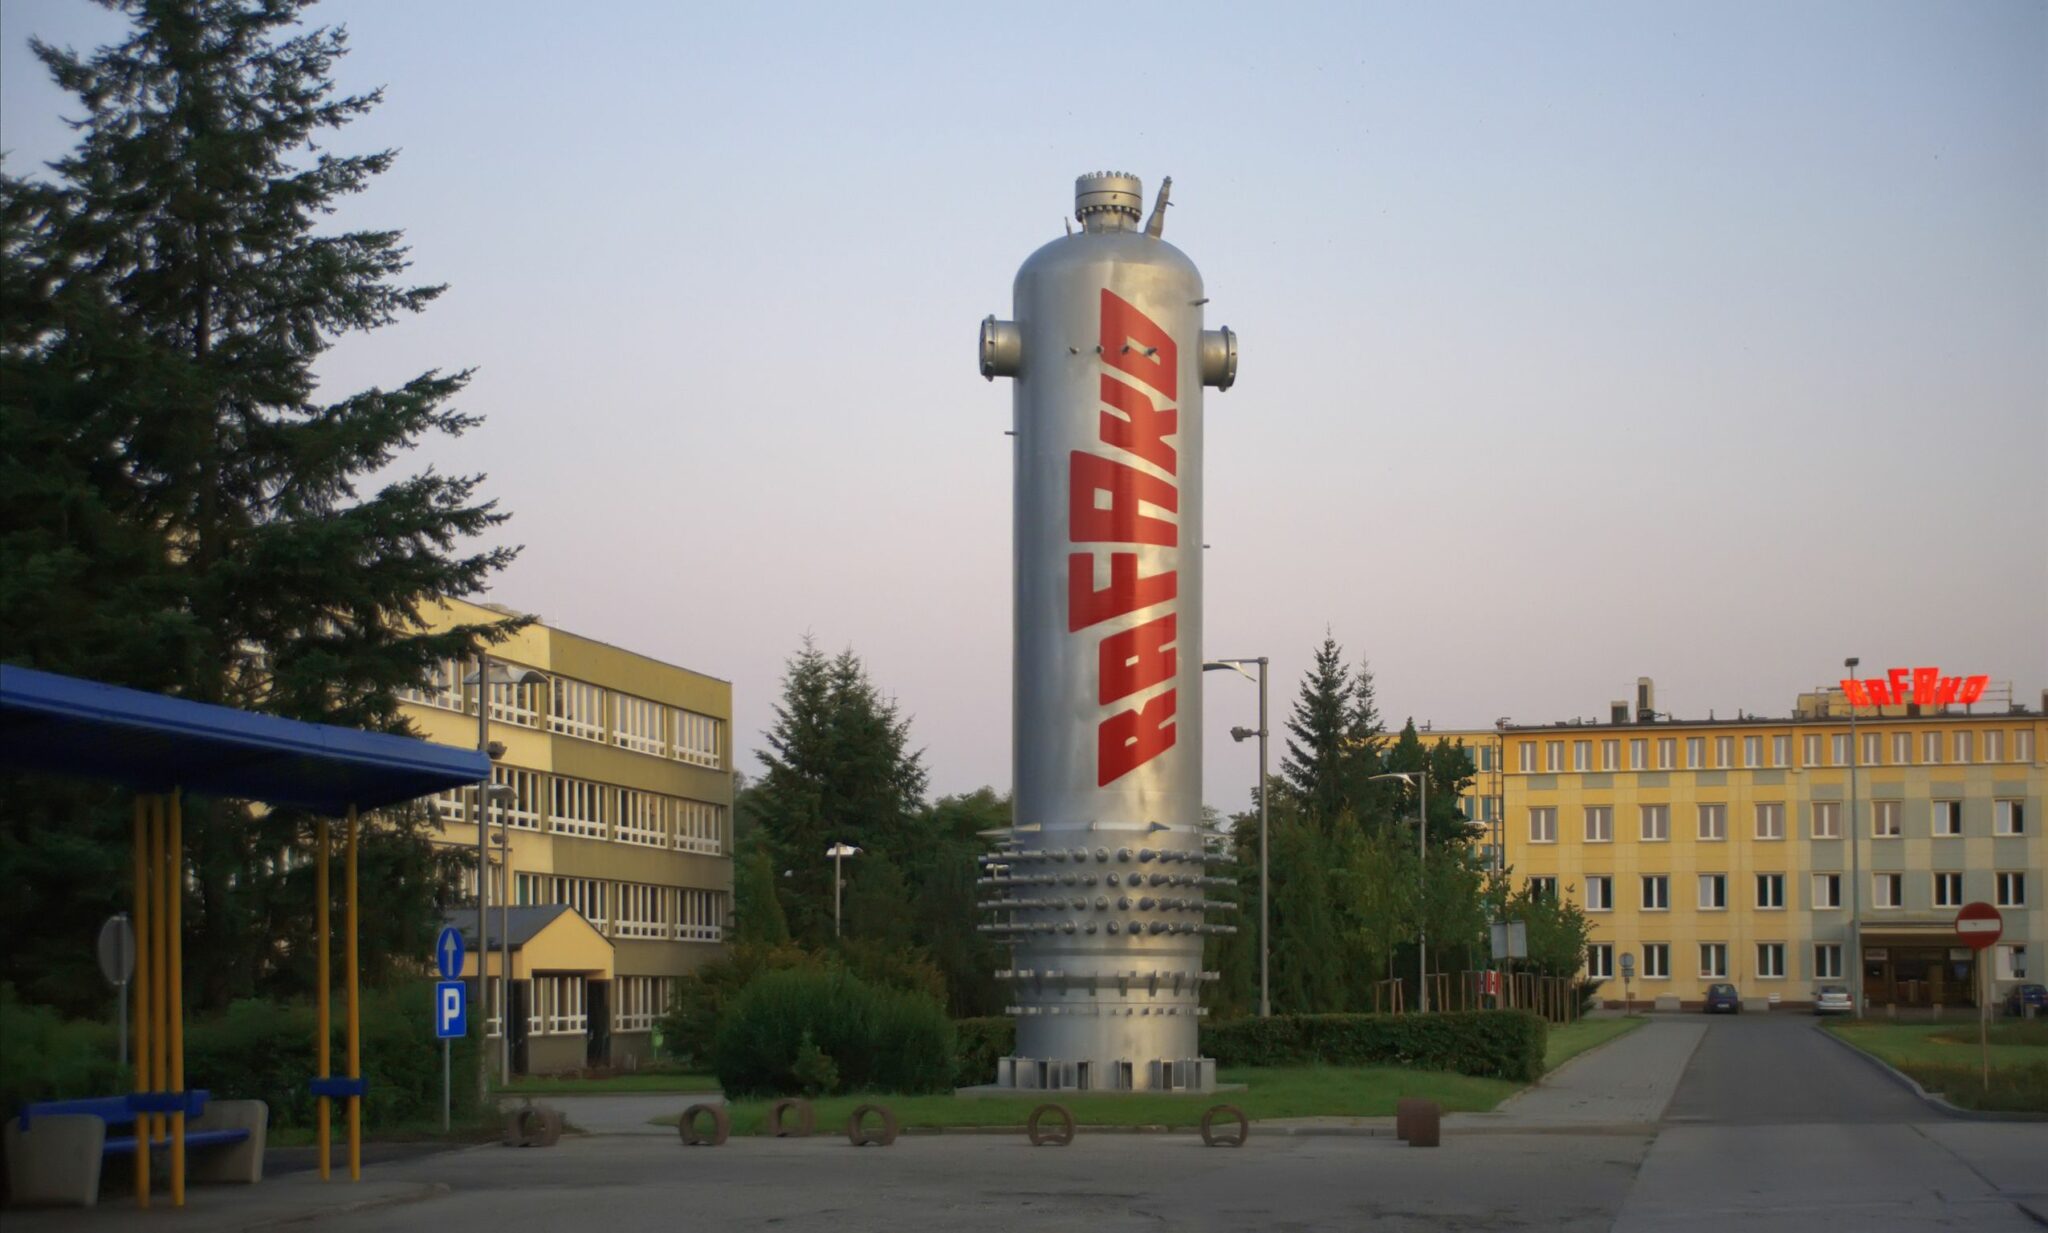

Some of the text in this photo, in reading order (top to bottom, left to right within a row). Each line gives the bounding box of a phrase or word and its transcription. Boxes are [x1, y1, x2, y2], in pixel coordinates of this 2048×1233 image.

[1068, 287, 1177, 787] RAFAKO
[1840, 667, 1989, 707] RAFAKO
[443, 987, 460, 1030] P
